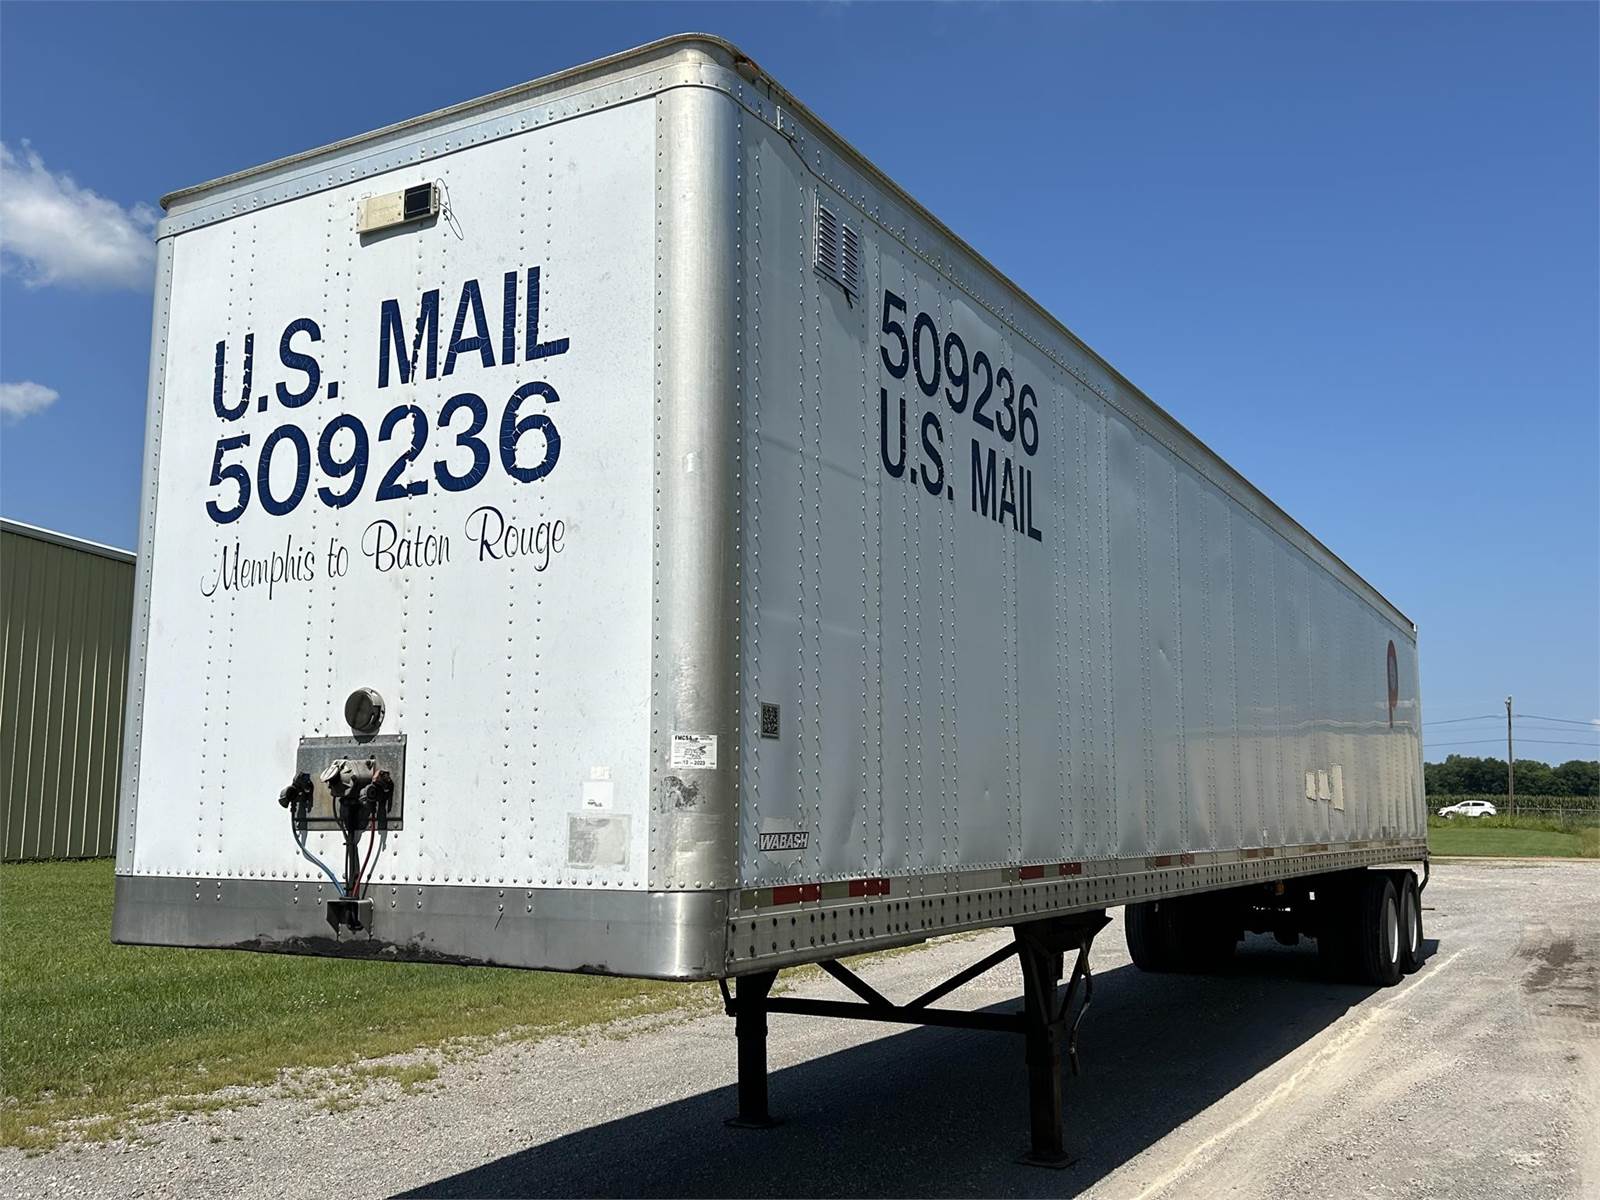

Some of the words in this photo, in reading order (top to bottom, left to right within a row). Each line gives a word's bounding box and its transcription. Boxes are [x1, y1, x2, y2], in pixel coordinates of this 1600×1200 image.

[212, 317, 339, 422] U.S.
[377, 265, 570, 389] MAIL
[879, 288, 1039, 457] 509236
[205, 381, 562, 525] 509236
[880, 386, 954, 501] U.S.
[971, 438, 1043, 543] MAIL
[200, 534, 315, 600] Memphis
[327, 536, 349, 578] to
[361, 519, 450, 572] Baton
[464, 506, 565, 572] Rouge
[760, 833, 809, 850] WABASH
